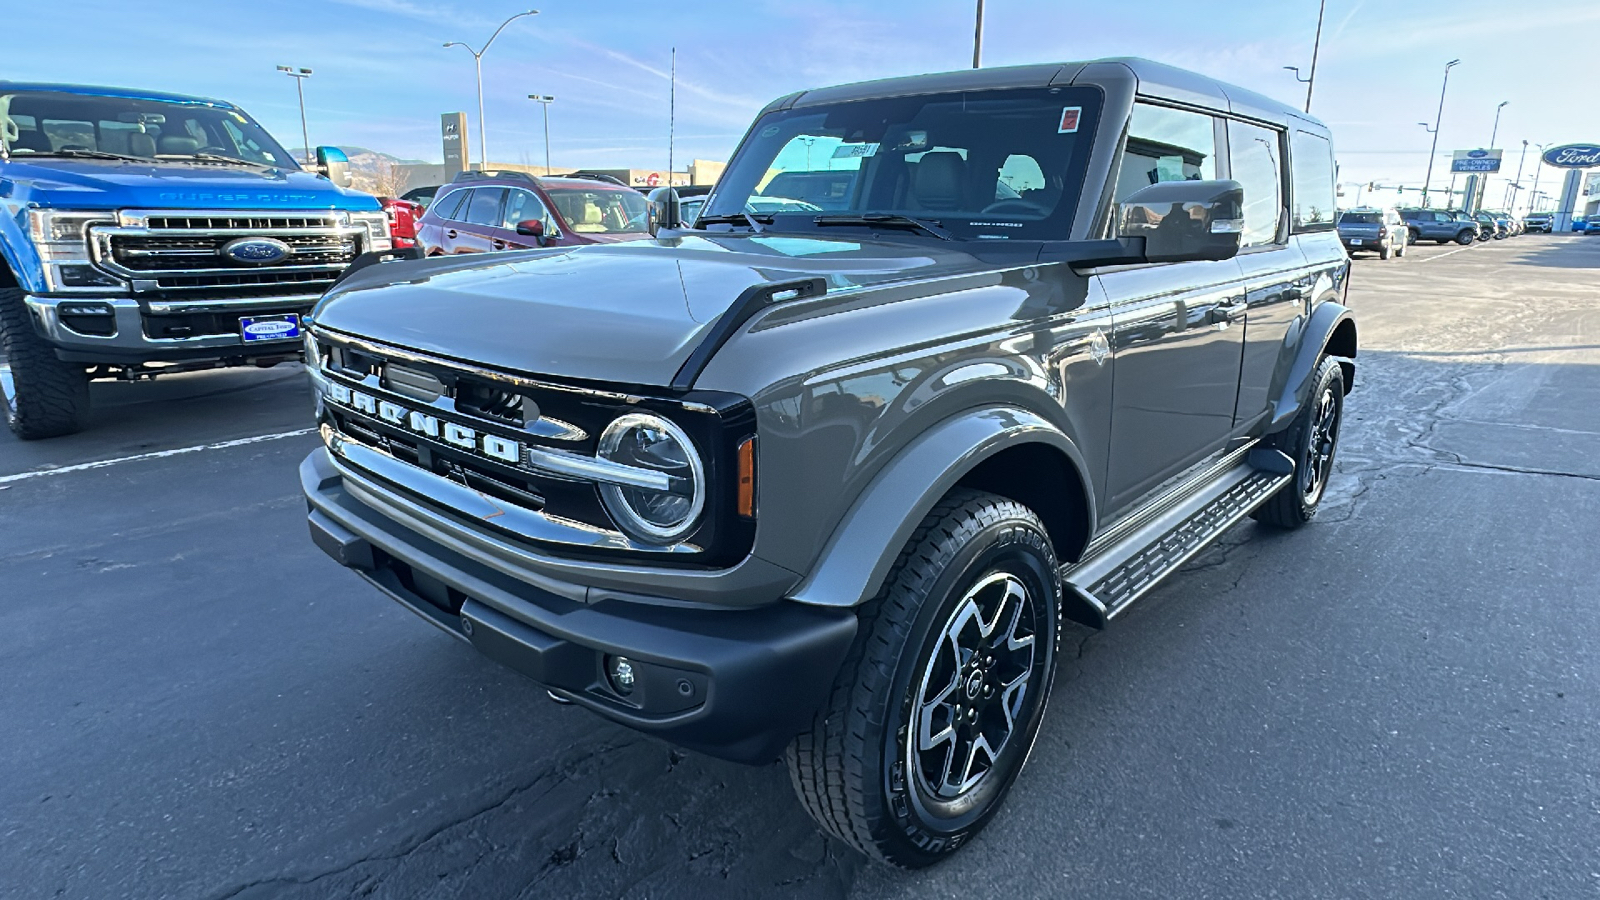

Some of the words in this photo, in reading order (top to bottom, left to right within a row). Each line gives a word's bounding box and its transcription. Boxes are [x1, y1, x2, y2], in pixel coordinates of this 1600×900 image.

[1556, 148, 1600, 163] Ford
[244, 244, 275, 258] Ford
[328, 381, 520, 463] BRONCO
